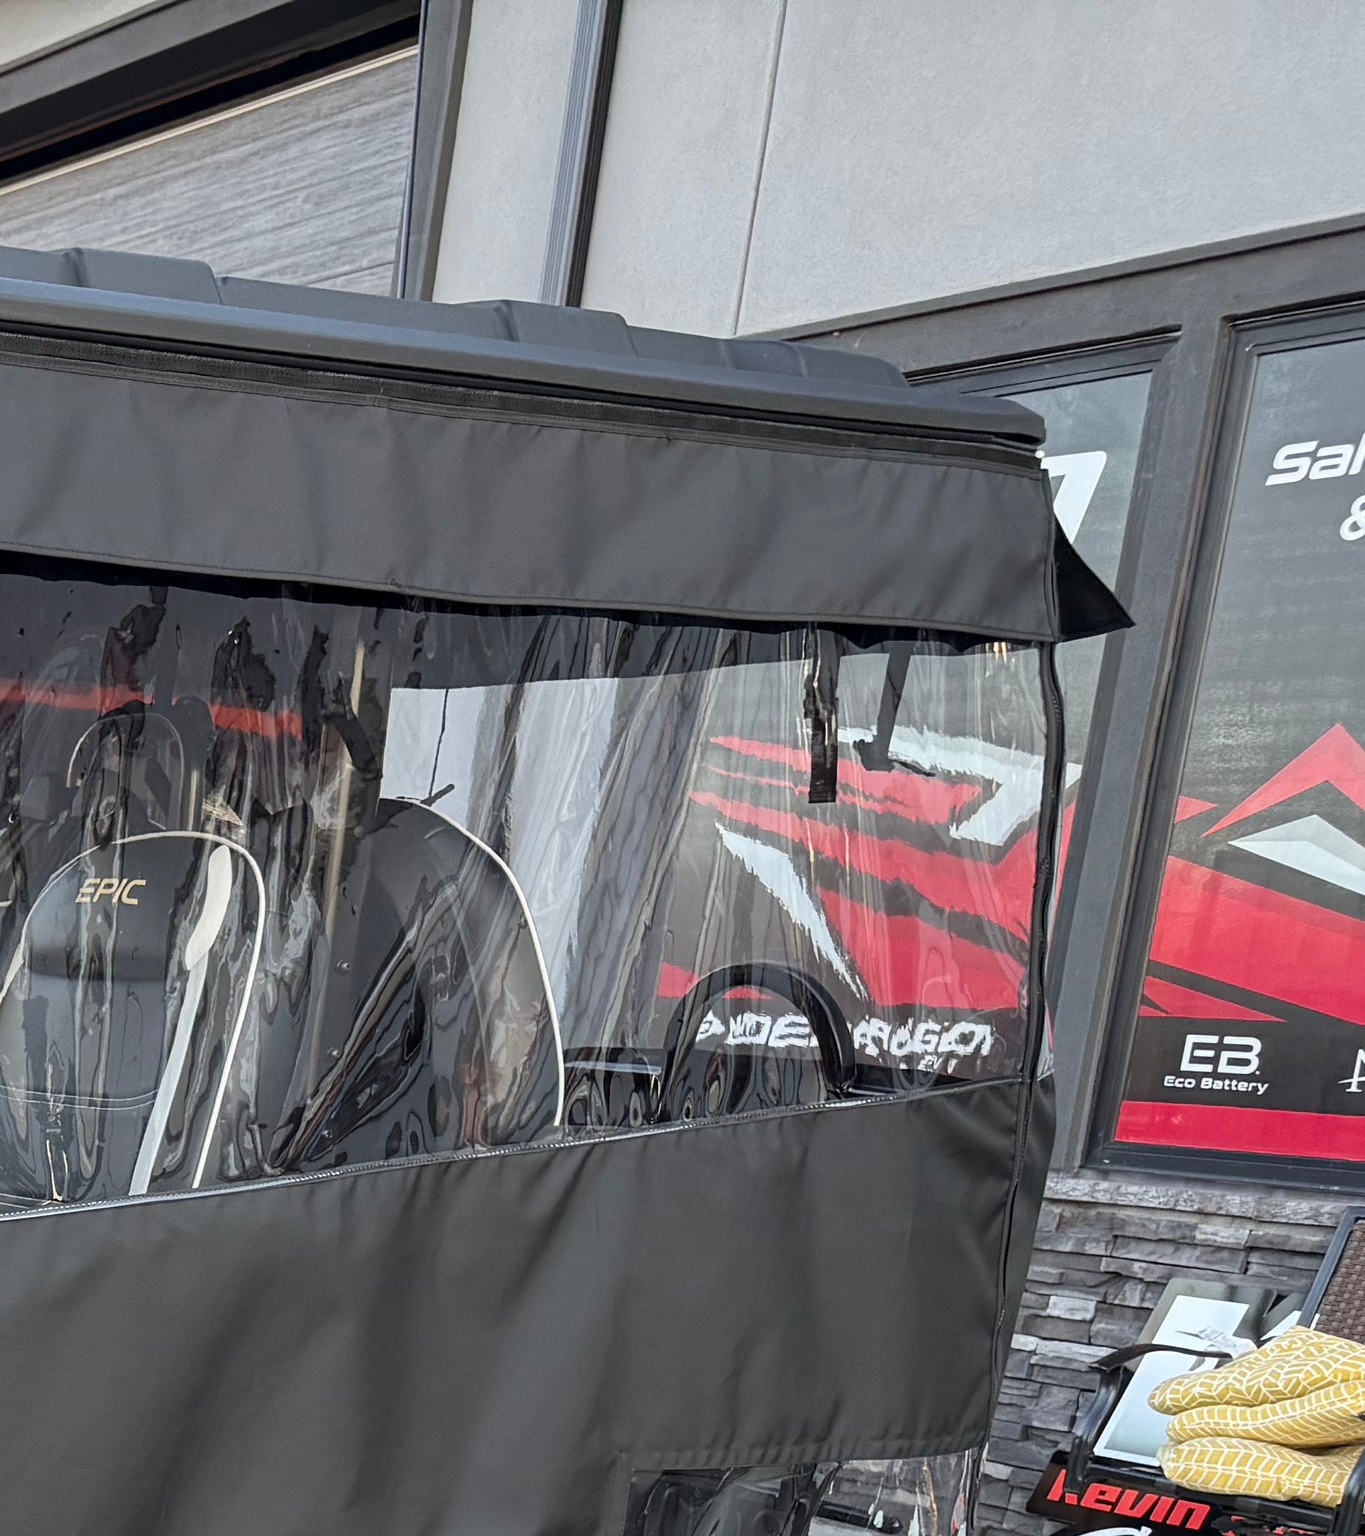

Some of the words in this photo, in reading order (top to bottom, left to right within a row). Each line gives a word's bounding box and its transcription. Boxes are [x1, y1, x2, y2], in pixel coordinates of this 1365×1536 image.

[75, 878, 146, 905] EPIC
[1180, 1034, 1262, 1075] EB
[1164, 1075, 1196, 1088] Eco
[1200, 1077, 1269, 1096] Battery
